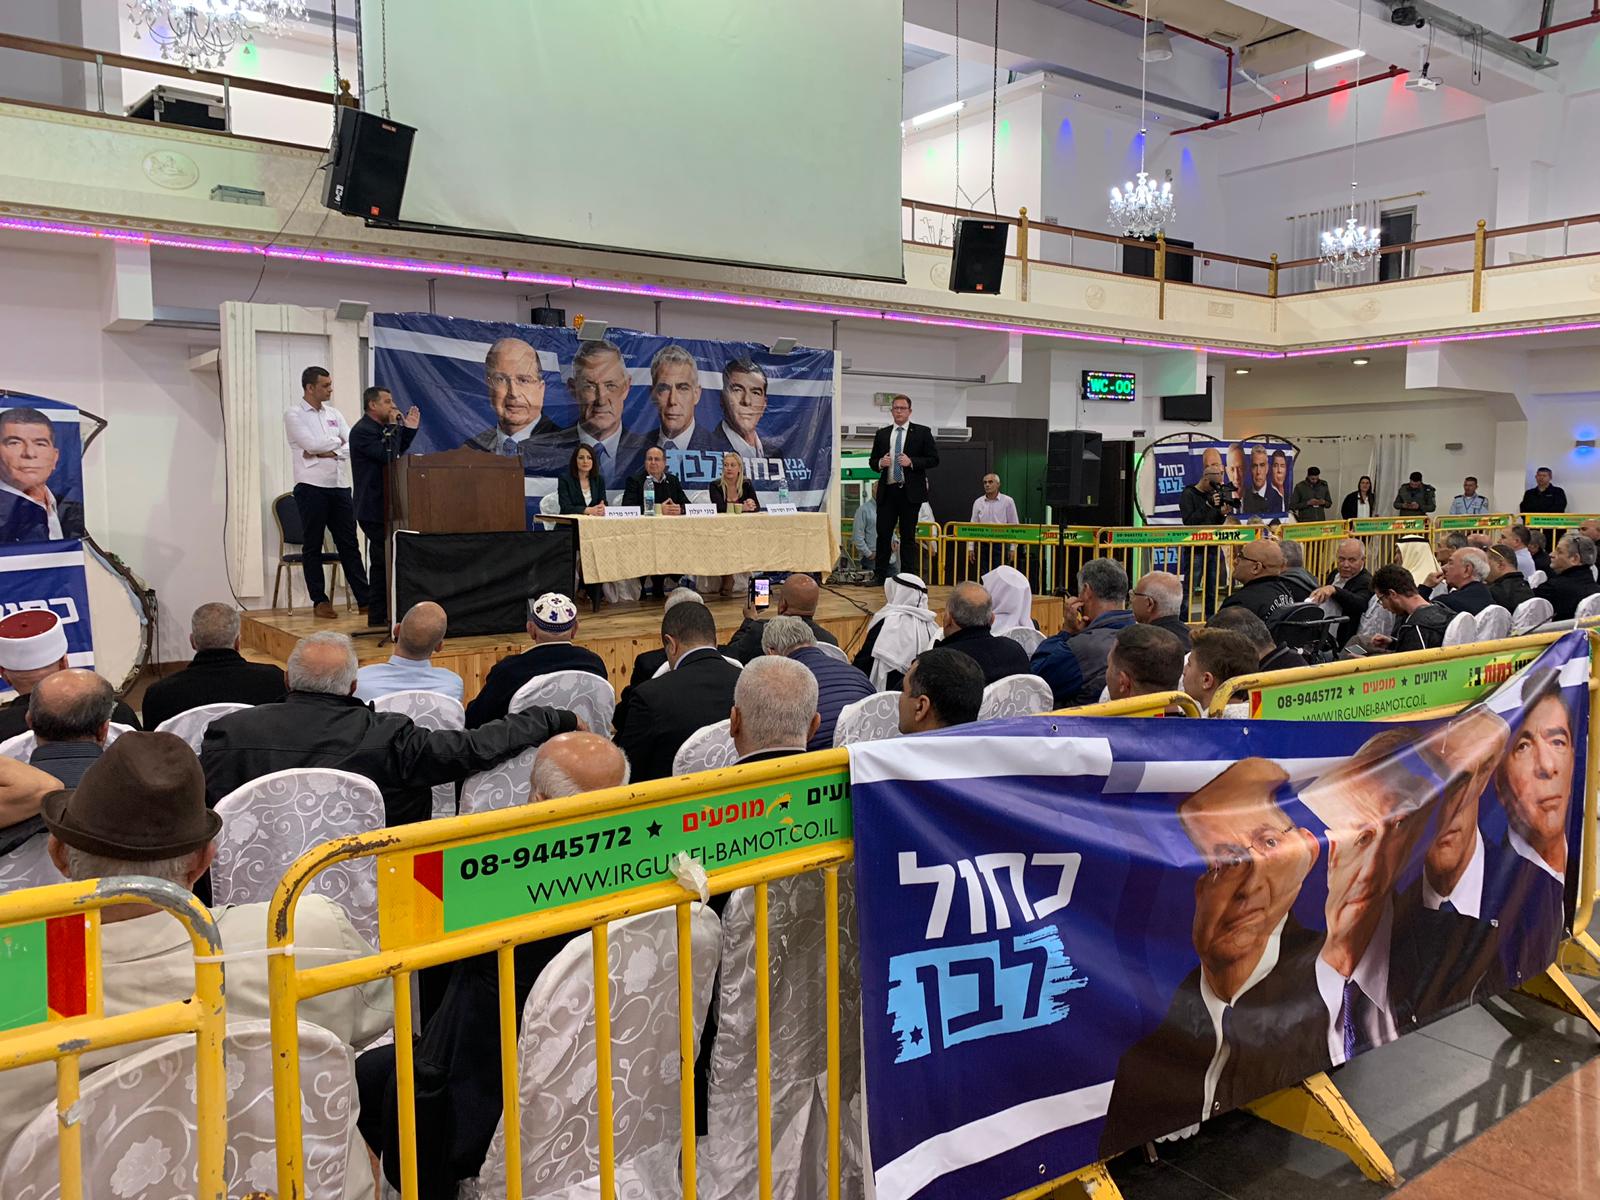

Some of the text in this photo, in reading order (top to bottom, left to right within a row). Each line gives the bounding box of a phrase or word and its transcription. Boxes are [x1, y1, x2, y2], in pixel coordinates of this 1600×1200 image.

[742, 457, 785, 481] כחו
[784, 458, 806, 469] גנץ
[786, 468, 811, 480] לפיד
[1159, 463, 1185, 478] כחול
[1161, 477, 1181, 493] לבן
[1362, 677, 1396, 695] מופעים
[1414, 668, 1448, 687] אירועים
[1277, 686, 1343, 709] 08-9445772
[682, 798, 765, 833] מופעים
[459, 826, 632, 880] 08-9445772
[527, 817, 839, 905] WWW.IRGUEI-BAMOT.CO.IL
[898, 851, 1082, 940] כחול
[913, 934, 1051, 1057] לבן
